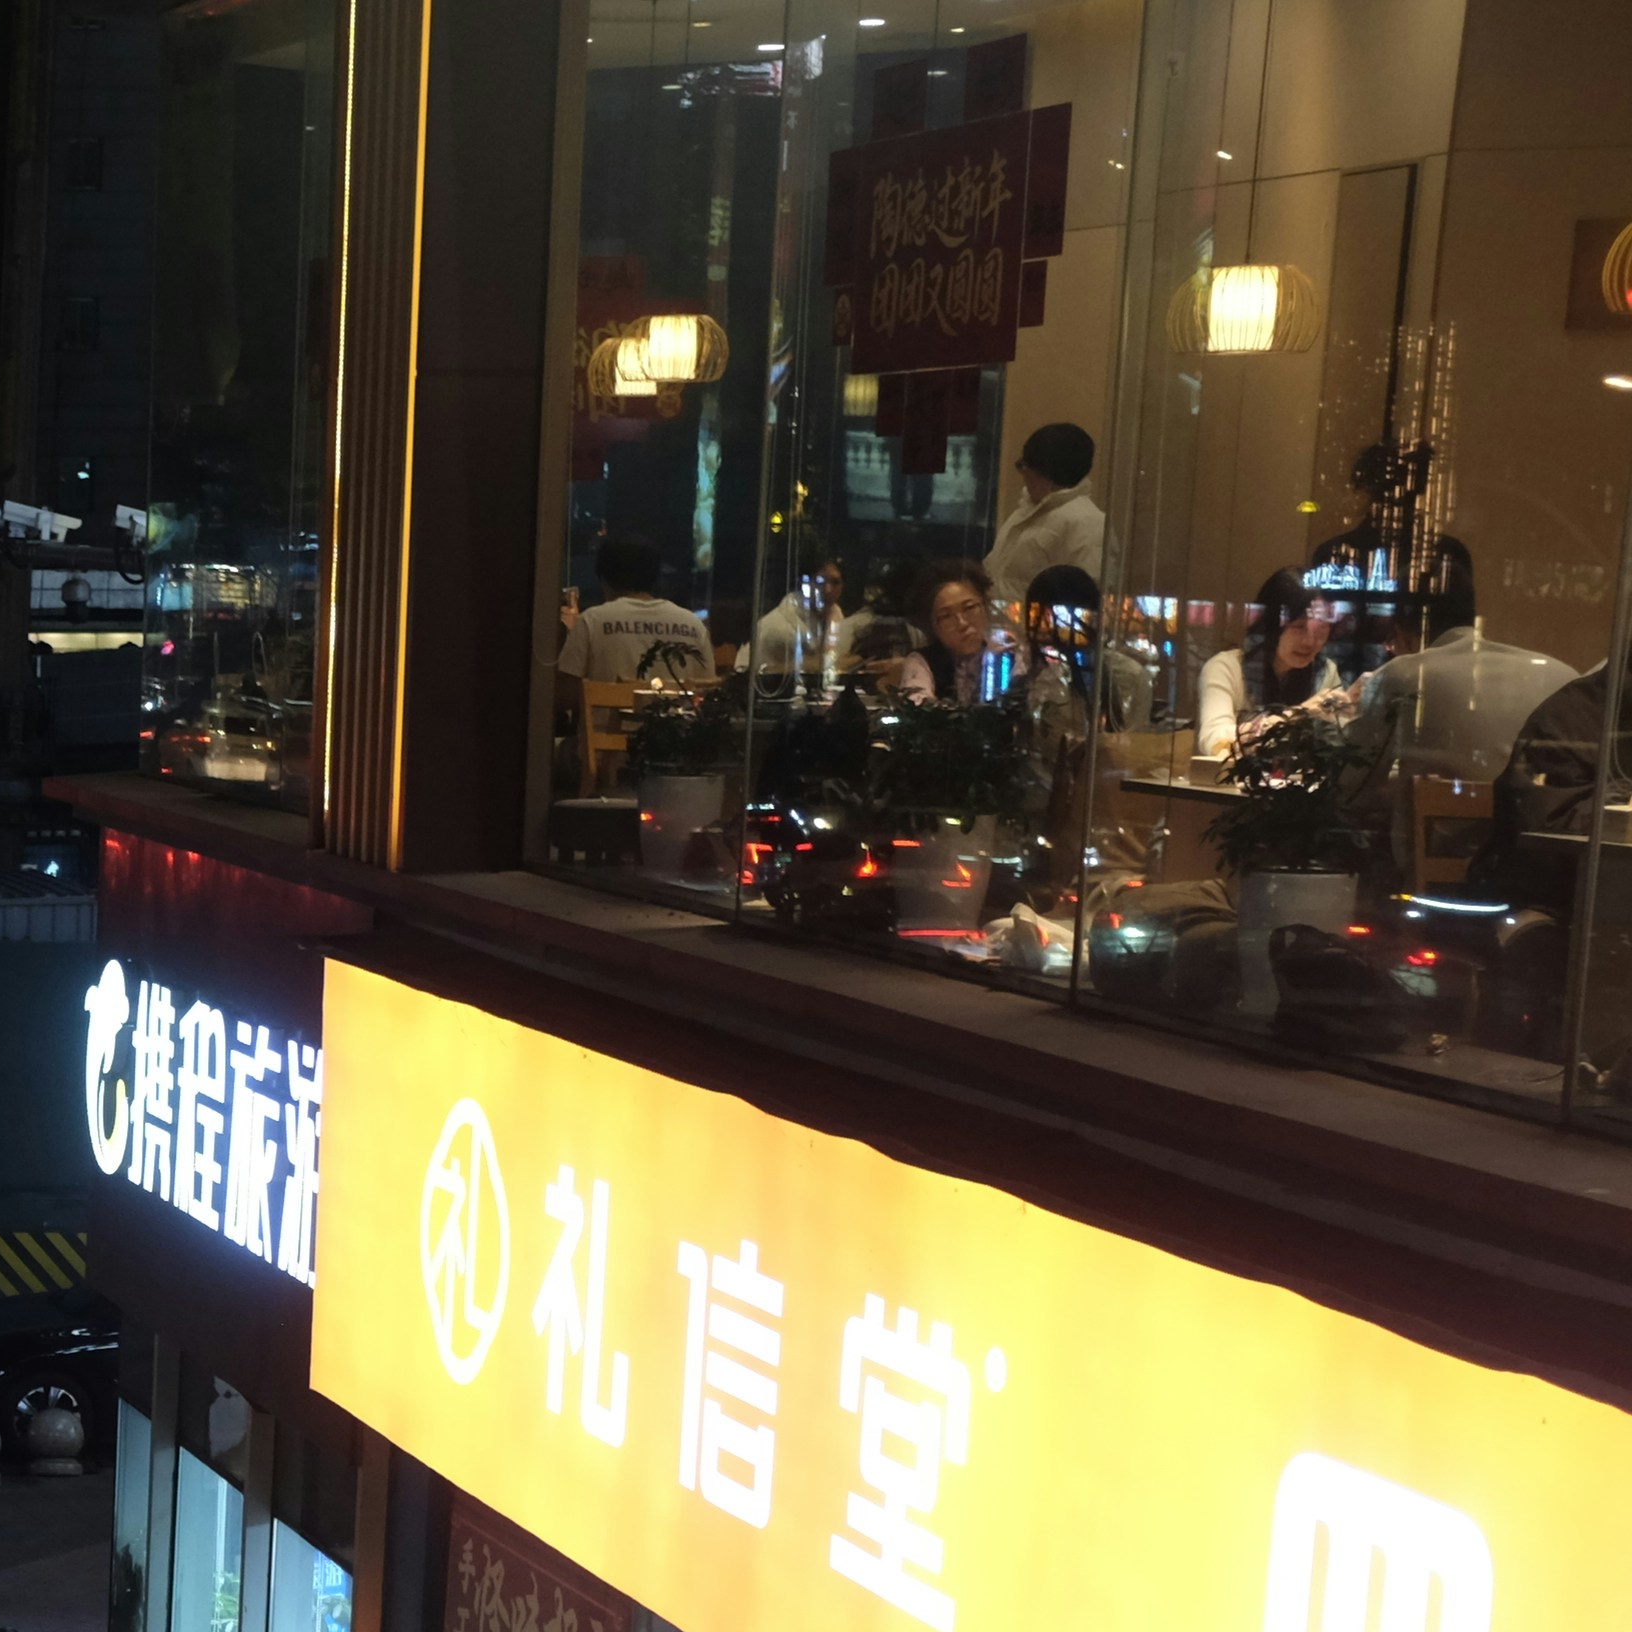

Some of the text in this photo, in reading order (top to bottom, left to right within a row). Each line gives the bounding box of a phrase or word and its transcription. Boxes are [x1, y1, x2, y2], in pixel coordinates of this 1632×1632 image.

[869, 149, 1012, 260] 陶德过新年
[869, 246, 1004, 338] 团团又圆圆
[603, 621, 699, 638] BALENCIAGA
